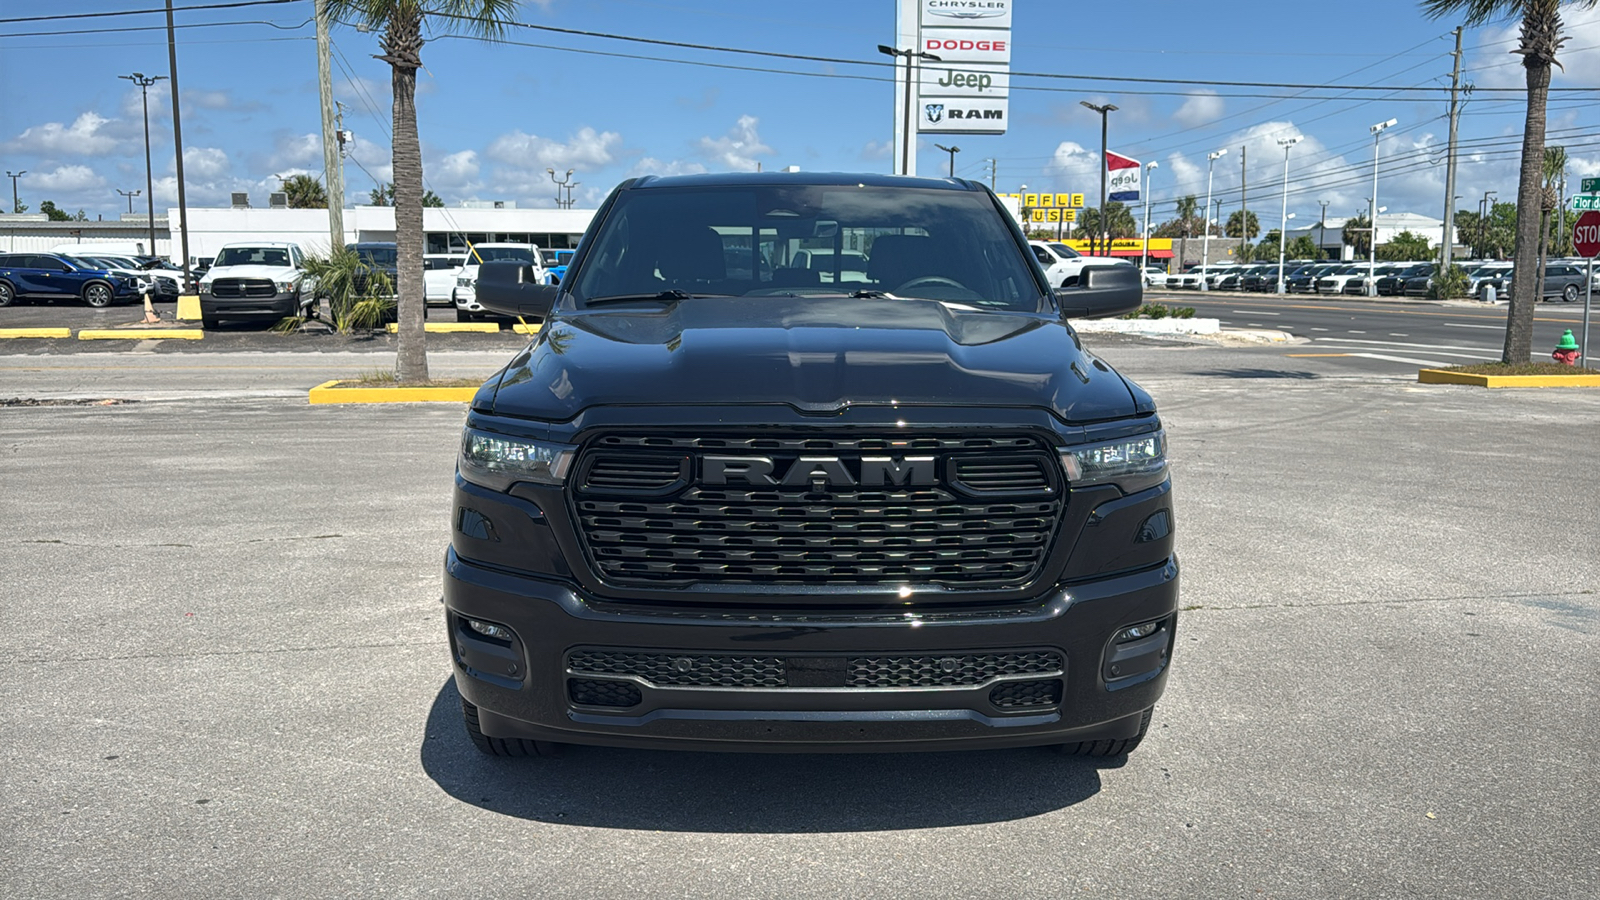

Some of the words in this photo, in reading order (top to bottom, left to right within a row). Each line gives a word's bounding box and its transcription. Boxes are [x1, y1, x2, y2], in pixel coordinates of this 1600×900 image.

[926, 40, 1006, 51] DODGE
[938, 70, 992, 92] Jeep
[948, 109, 1003, 120] RAM
[1026, 195, 1082, 206] FFLE
[1573, 196, 1600, 209] Florid
[1034, 210, 1074, 221] USE
[702, 455, 936, 485] RAM
